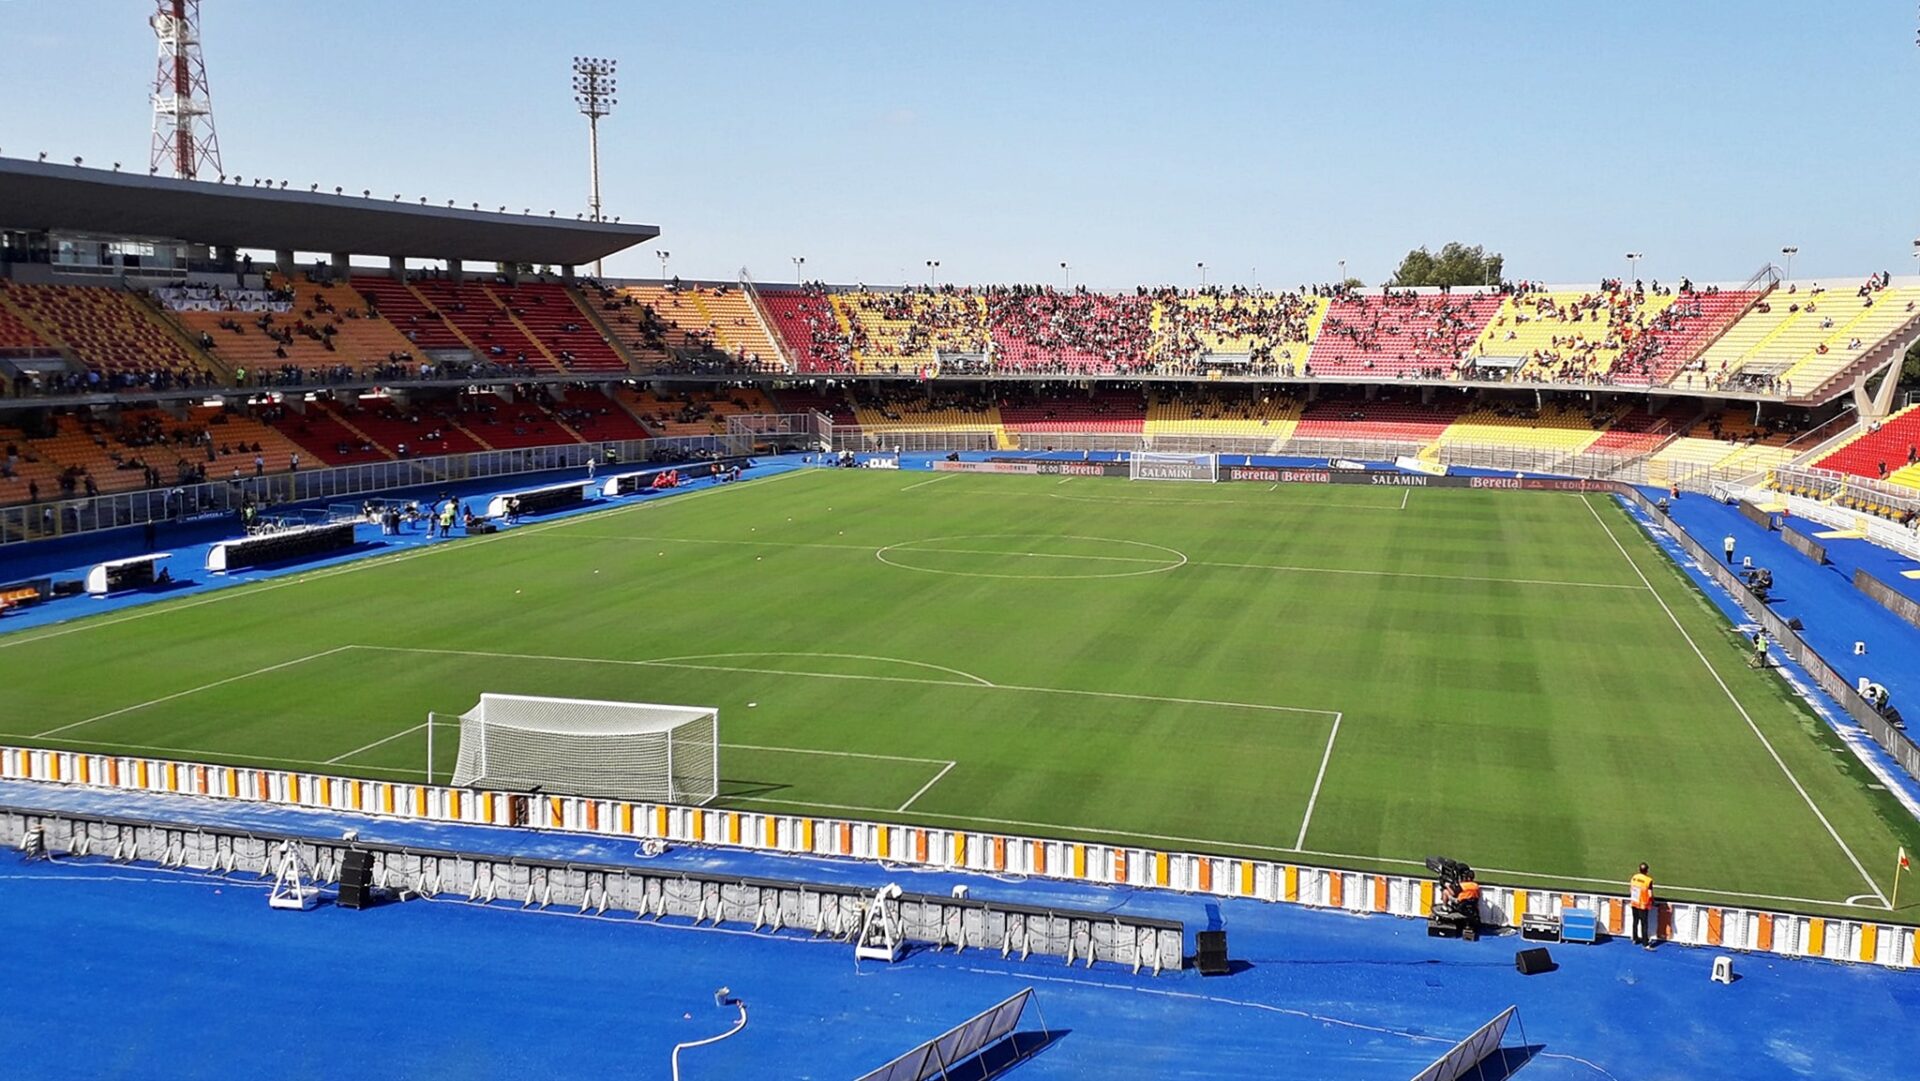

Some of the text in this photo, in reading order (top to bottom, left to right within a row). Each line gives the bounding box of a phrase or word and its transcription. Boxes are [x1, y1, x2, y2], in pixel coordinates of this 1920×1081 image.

[1062, 464, 1101, 475] Beretta
[1140, 468, 1192, 478] SALAMINI
[1234, 469, 1275, 480] Beretta
[1285, 471, 1327, 482] Beretta
[1371, 475, 1427, 485] SALAMINI
[1473, 477, 1519, 488] Beretta
